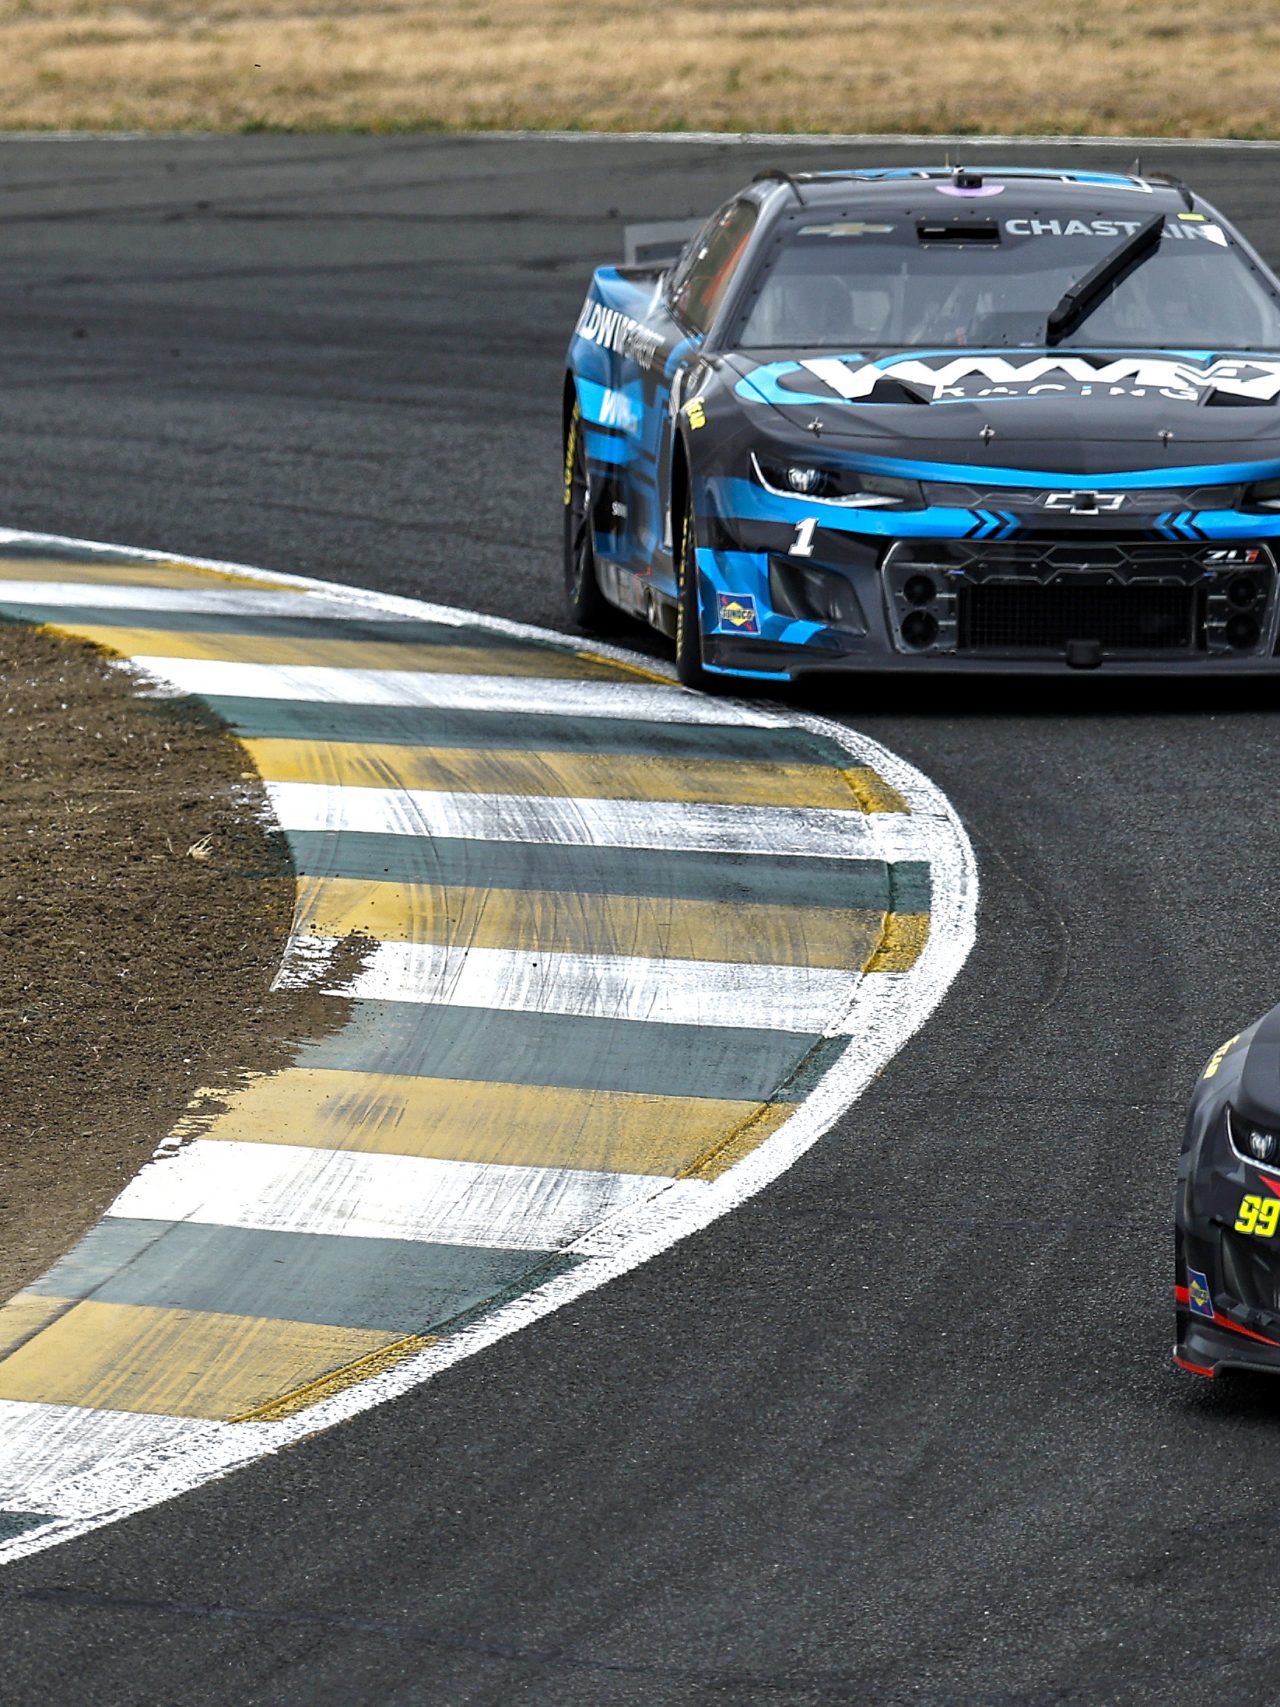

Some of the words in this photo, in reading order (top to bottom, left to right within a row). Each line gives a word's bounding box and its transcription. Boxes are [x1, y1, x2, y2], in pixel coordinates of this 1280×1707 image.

[1004, 218, 1207, 240] CHASTIN
[788, 517, 819, 557] 1
[1202, 550, 1259, 564] ZL1
